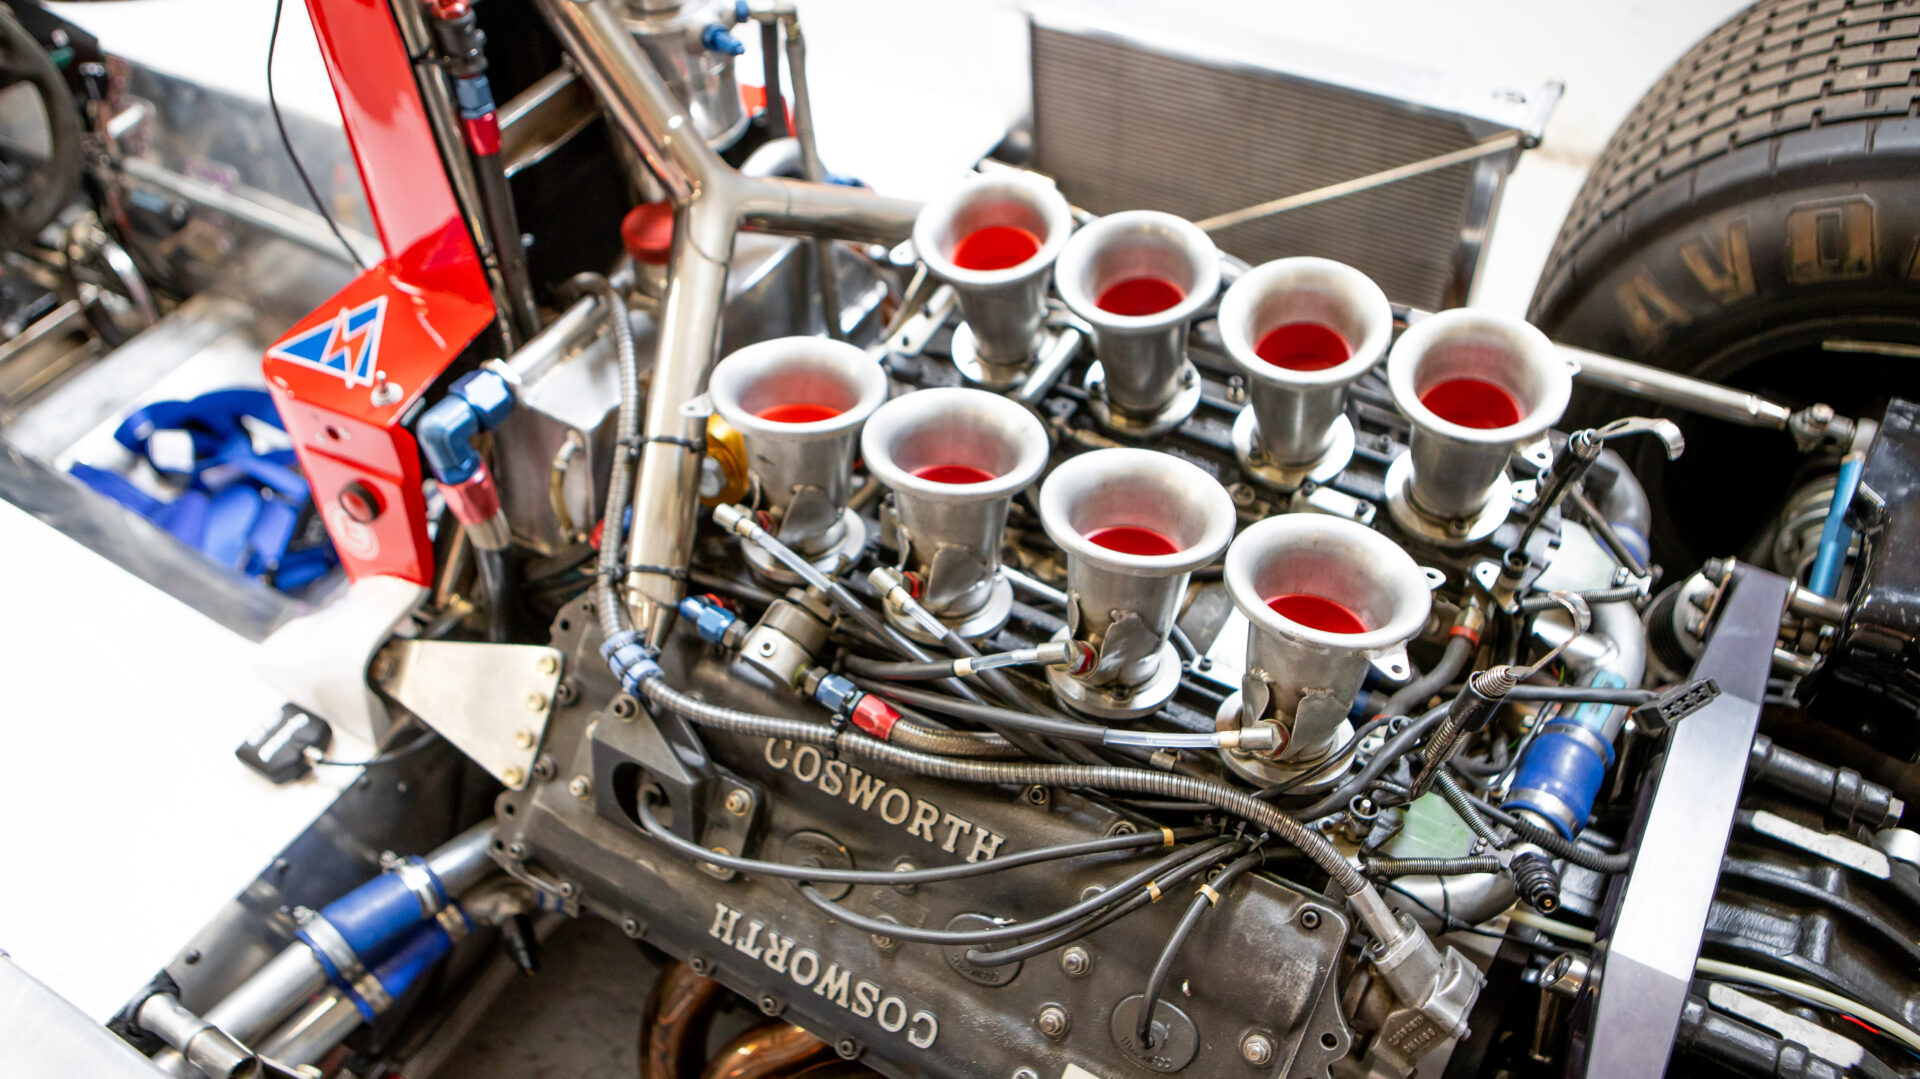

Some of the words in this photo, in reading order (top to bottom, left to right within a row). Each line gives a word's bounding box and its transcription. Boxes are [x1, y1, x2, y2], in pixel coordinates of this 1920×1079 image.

[1614, 193, 1920, 353] AVO
[764, 736, 1006, 864] COSWORTH
[708, 902, 940, 1049] COSWORTH
[1388, 1014, 1424, 1045] COSWORTH
